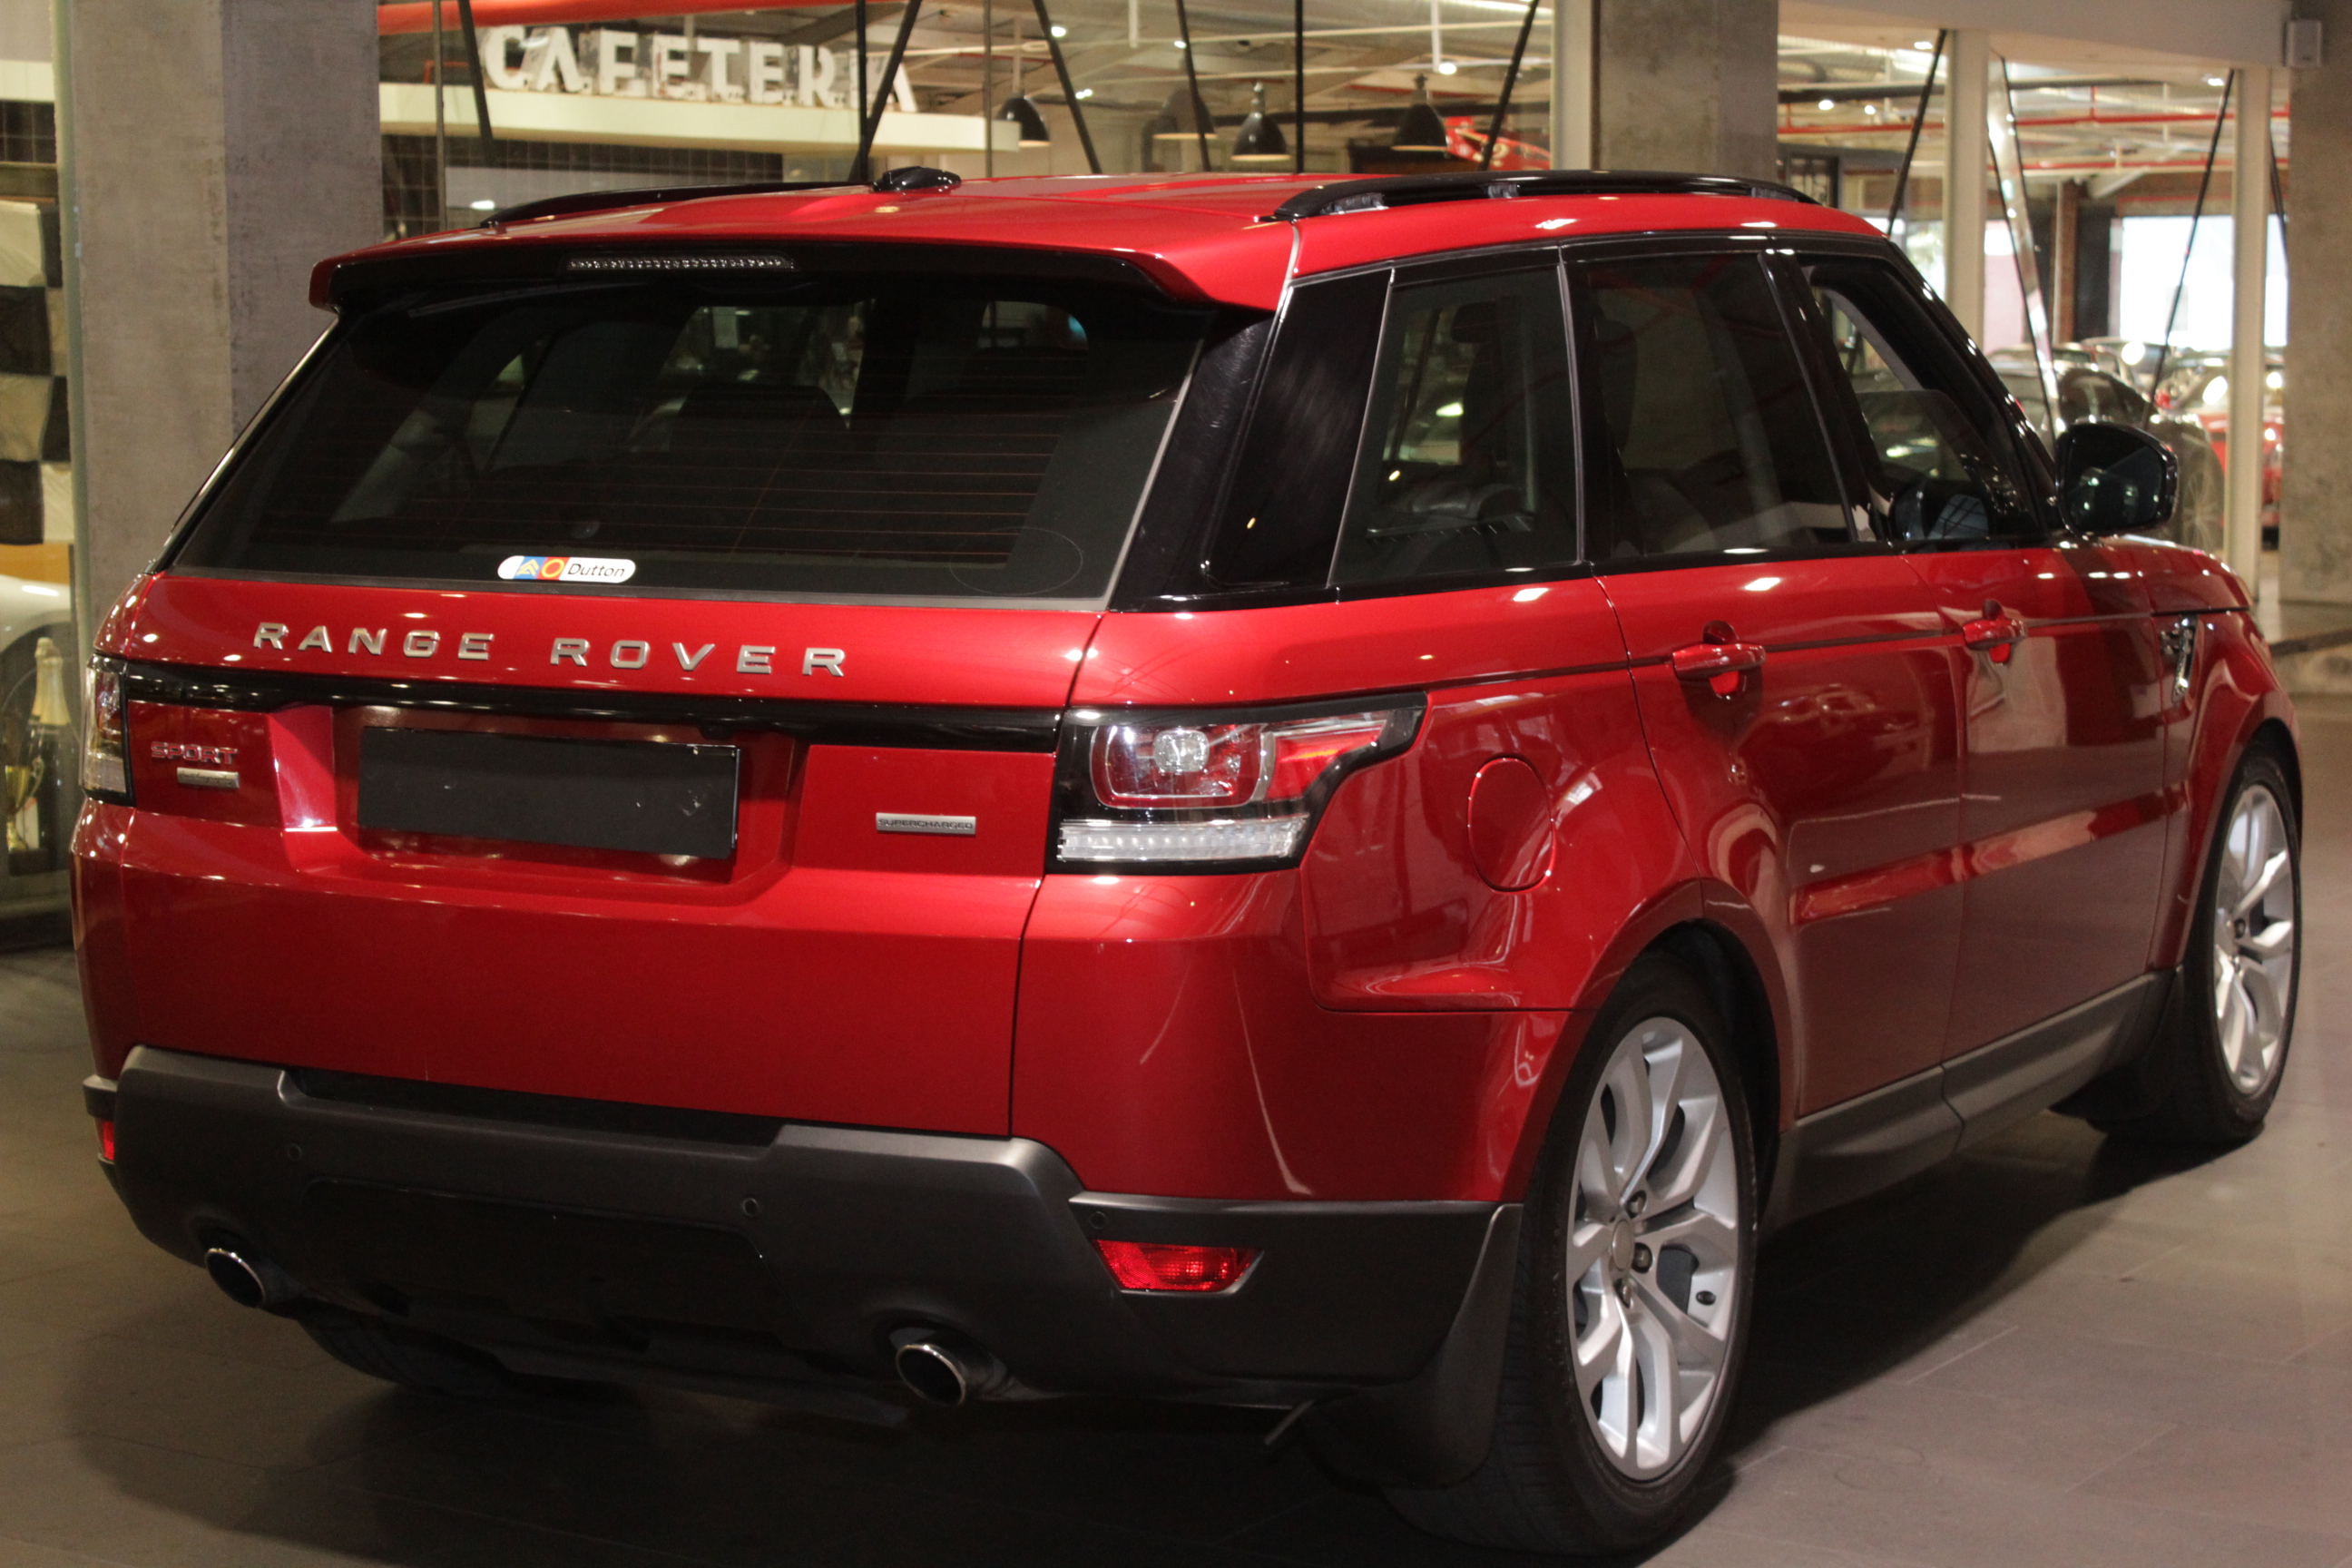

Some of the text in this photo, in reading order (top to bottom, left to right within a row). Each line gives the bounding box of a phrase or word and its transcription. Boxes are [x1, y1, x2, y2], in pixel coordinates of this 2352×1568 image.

[567, 563, 624, 577] Dutton
[253, 622, 845, 677] RANGE ROVER
[151, 741, 238, 764] SPORT
[878, 818, 974, 829] SUPERCHARGED
